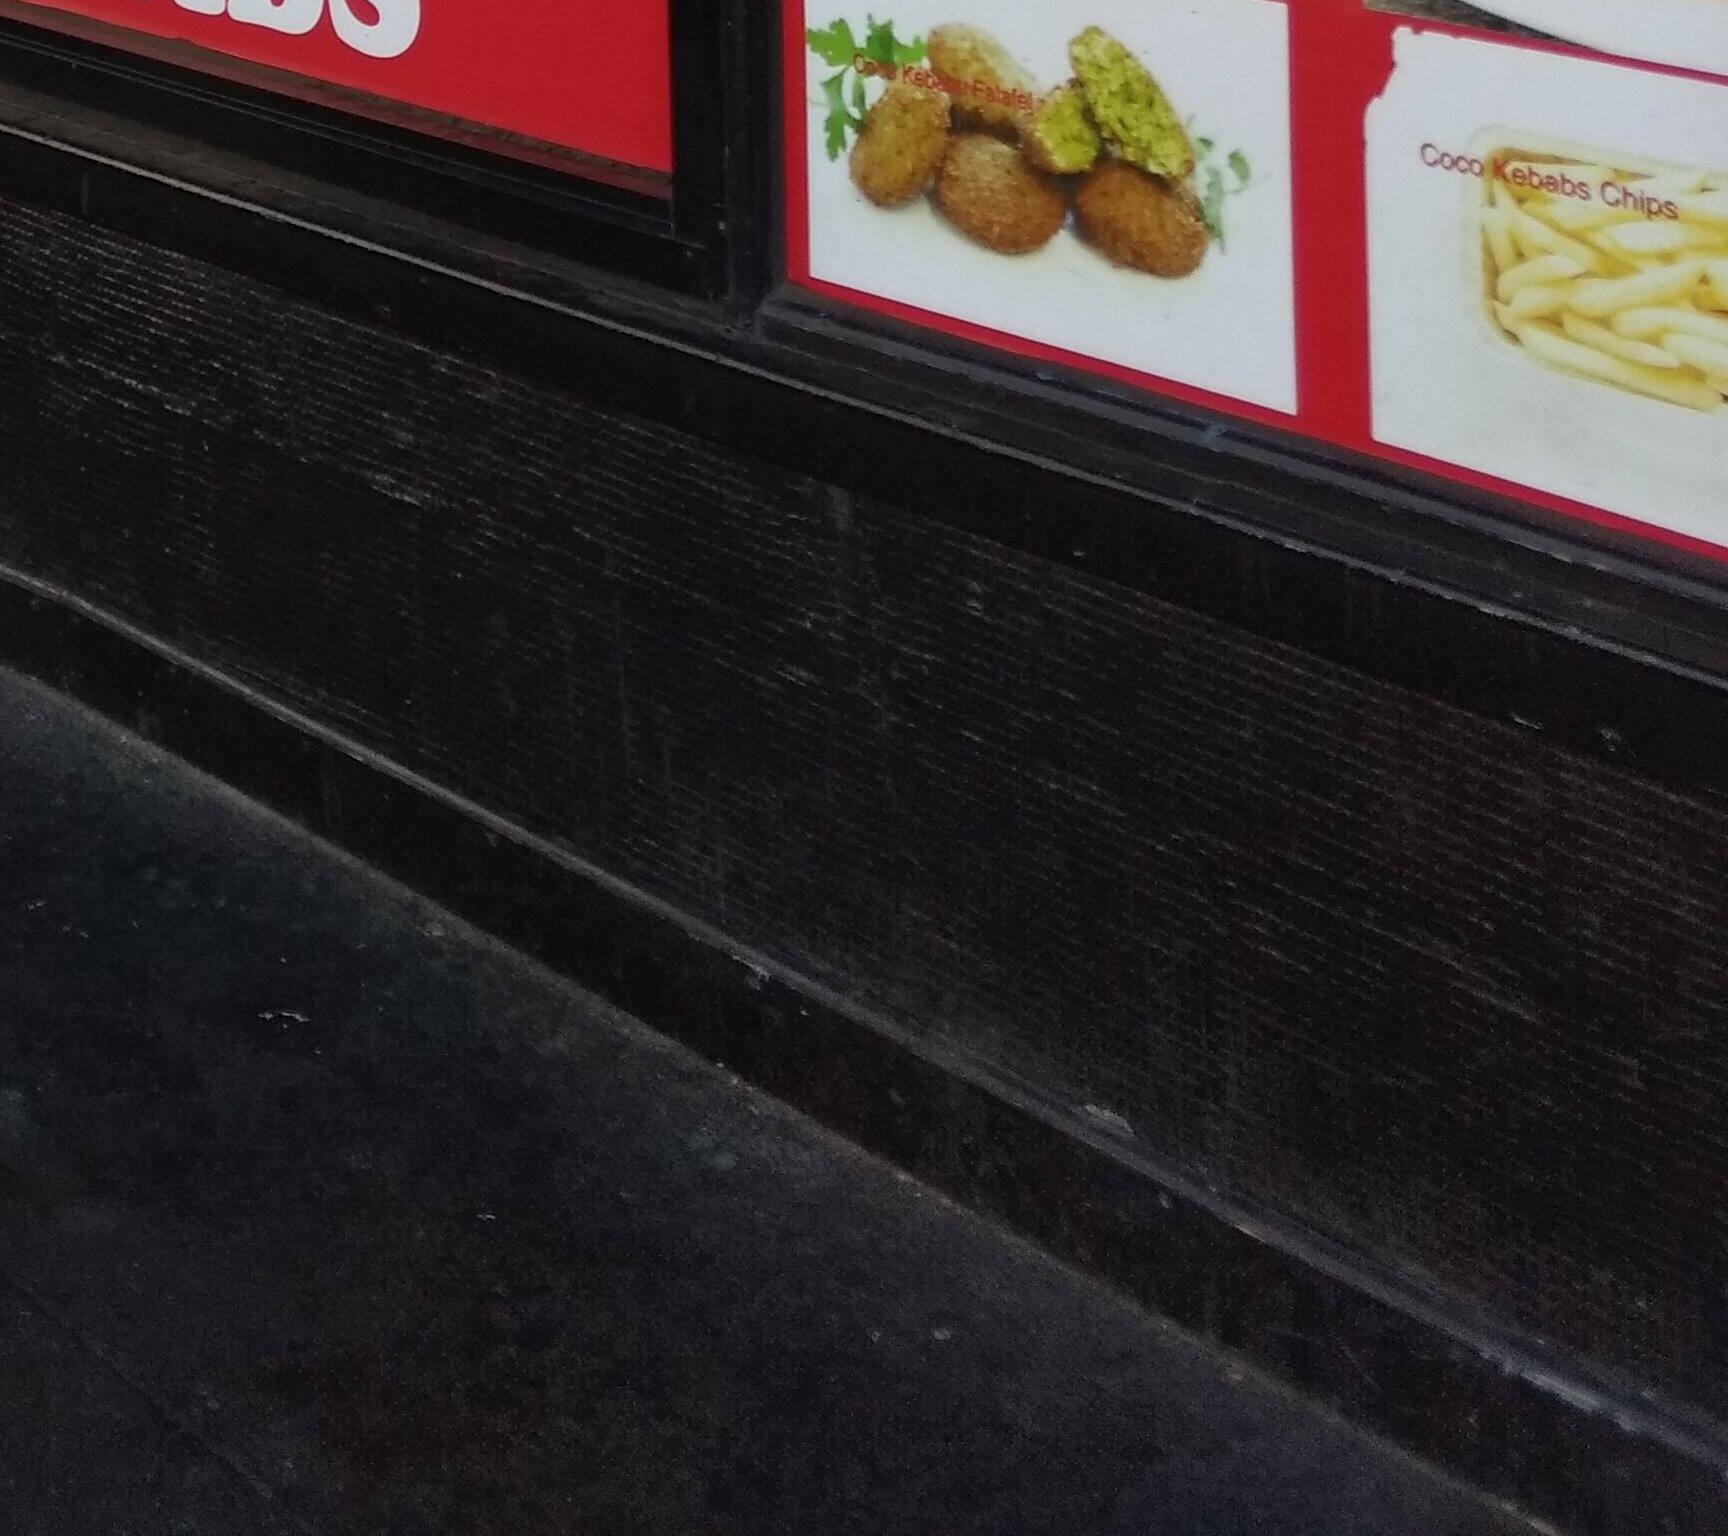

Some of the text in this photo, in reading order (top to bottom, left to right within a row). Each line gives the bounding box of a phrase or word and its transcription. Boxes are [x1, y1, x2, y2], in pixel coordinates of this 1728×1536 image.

[1420, 142, 1680, 221] Coco Kebabs Chips
